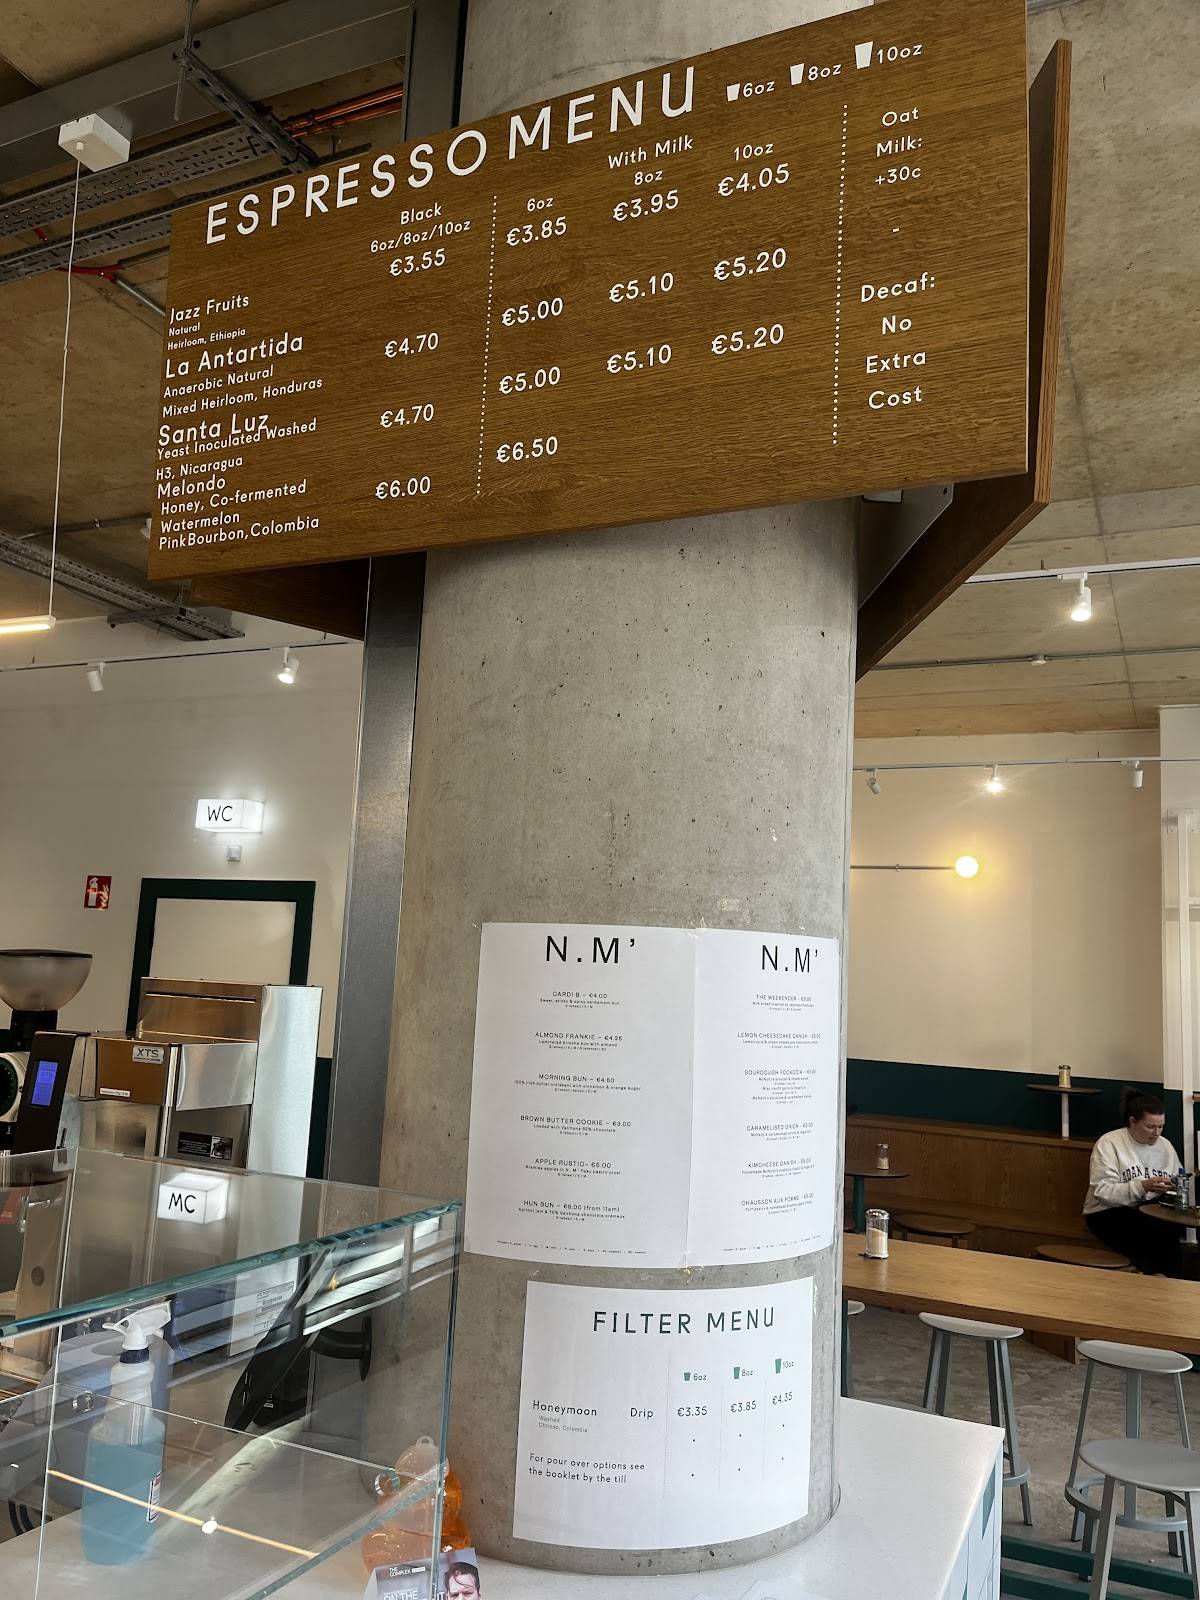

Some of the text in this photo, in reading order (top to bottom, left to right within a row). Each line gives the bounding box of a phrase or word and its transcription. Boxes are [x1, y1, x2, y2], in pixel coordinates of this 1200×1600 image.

[742, 44, 923, 98] 6oz 8oz 10oz
[881, 107, 919, 127] Oat
[206, 66, 695, 245] ESPRESSO MENU
[608, 134, 693, 169] With Milk
[876, 135, 923, 157] Milk:
[527, 143, 774, 212] 6oz 8oz 10oz
[875, 165, 921, 185] +30c
[400, 202, 442, 225] Black
[169, 162, 790, 325] Jazz Fruits €3.55 €3.85 €3.95 €4.05
[370, 220, 471, 253] 6oz/8oz/10oz
[861, 271, 935, 303] Decaf:
[165, 247, 787, 379] La Antartida €4.70 €5.00 €5.10 €5.20
[168, 322, 201, 337] Natural
[881, 315, 912, 335] No
[167, 328, 246, 351] Heirloom, Ethiopia
[866, 352, 926, 374] Extra
[158, 323, 784, 447] Santa Luz €4.70 €5.00 €5.10 €5.20
[163, 364, 274, 399] Anaerobic Natural
[162, 378, 323, 418] Mixed Heirloom, Honduras
[868, 385, 922, 410] Cost
[157, 417, 317, 460] Yeast Inoculated Washed
[156, 457, 243, 480] H3, Nicaragua
[157, 435, 558, 500] Melondo €6.00 €6.50
[161, 478, 307, 515] Honey, Co-fermented
[160, 511, 240, 534] Watermelon
[207, 804, 234, 823] WC
[535, 1031, 564, 1039] ALMOND
[136, 1048, 159, 1058] XTS
[538, 1073, 571, 1081] MORNING
[520, 1114, 545, 1122] BROWN
[575, 1118, 603, 1126] COOKIE
[592, 1306, 775, 1335] FILTER MENU
[692, 1372, 707, 1382] 6oz
[741, 1368, 754, 1377] 8oz
[532, 1391, 793, 1420] Honeymoon Drip €3.35 €3.85 €4.35
[529, 1452, 645, 1471] For pour over options see
[529, 1467, 627, 1484] the booklet by the till
